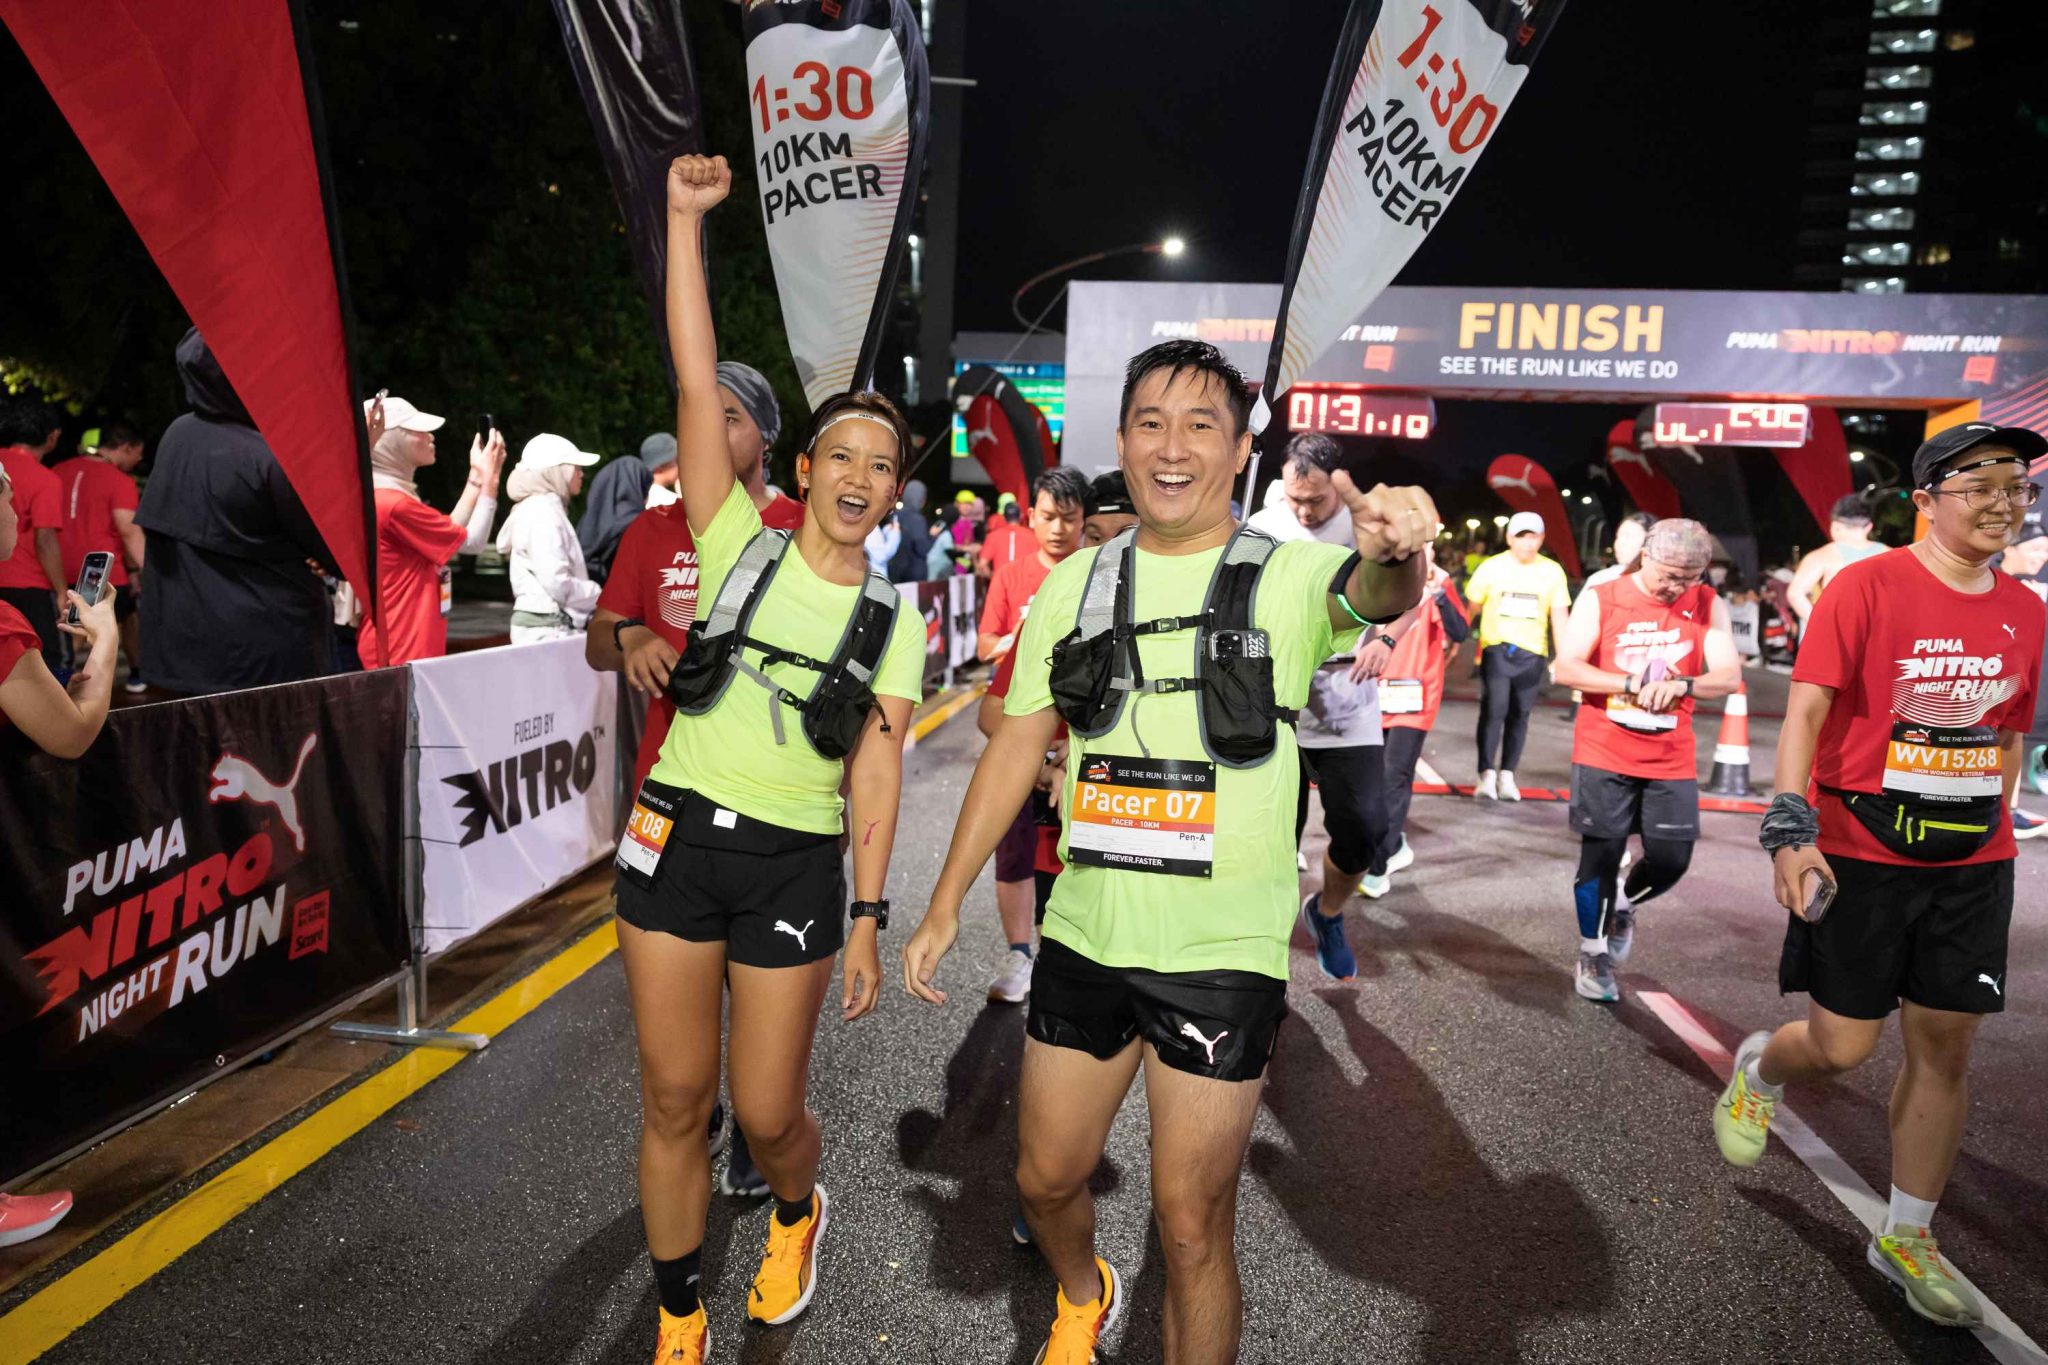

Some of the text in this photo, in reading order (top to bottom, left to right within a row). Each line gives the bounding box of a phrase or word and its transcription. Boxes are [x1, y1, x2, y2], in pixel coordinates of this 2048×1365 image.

[1397, 4, 1498, 154] 1:30
[753, 61, 874, 134] 1:30
[760, 132, 853, 183] 10KM
[1384, 98, 1466, 196] 10KM
[1345, 103, 1442, 233] PACER
[764, 163, 885, 225] PACER
[1459, 302, 1664, 352] FINISH
[1726, 329, 2002, 354] PUMA NITRO NIGHT RUN
[1439, 356, 1679, 379] SEE THE RUN LIKE WE DO
[1913, 639, 1964, 654] PUMA
[1894, 655, 2003, 682] NITRO
[1913, 679, 2008, 701] NIGHT RUN
[514, 712, 555, 745] FUELED BY
[1894, 742, 1997, 768] WV15268
[1117, 769, 1206, 783] SEE THE RUN LIKE WE DO
[1929, 768, 1960, 777] WOMEN'S
[440, 731, 596, 848] NITRO
[1082, 783, 1203, 820] Pacer 07
[642, 812, 665, 839] 08
[1111, 817, 1134, 827] PACER
[1140, 820, 1160, 829] 10KM
[1179, 832, 1206, 842] Pen-A
[63, 817, 187, 916] PUMA
[1103, 852, 1165, 867] FOREVER.FASTER.
[22, 832, 273, 1018] NITRO
[78, 883, 286, 1043] NIGHT RUN
